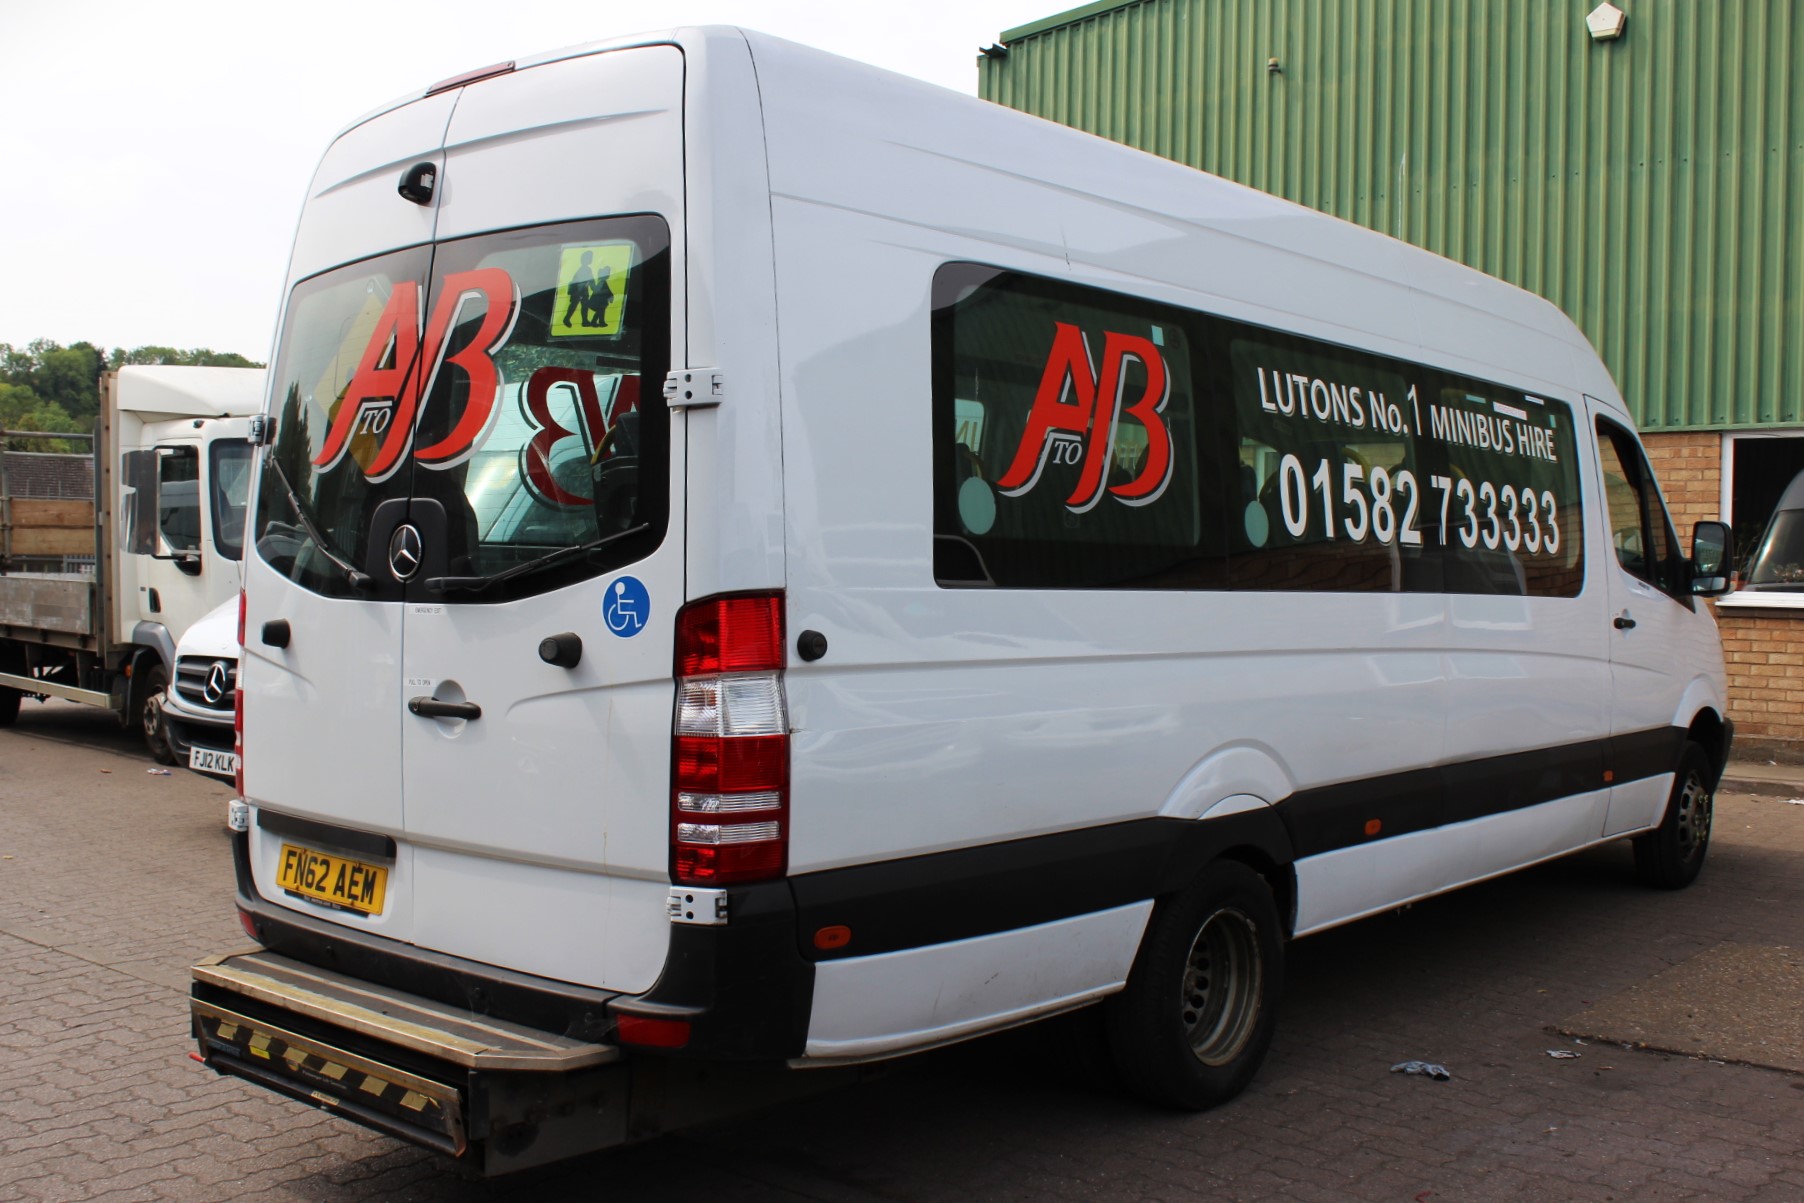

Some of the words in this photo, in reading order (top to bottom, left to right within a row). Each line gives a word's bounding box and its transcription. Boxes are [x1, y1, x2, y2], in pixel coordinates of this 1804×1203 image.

[360, 406, 391, 435] TO
[1257, 367, 1365, 429] LUTONS
[1430, 404, 1514, 454] MINIBUS
[1516, 423, 1557, 462] HIRE
[1053, 441, 1082, 465] TO
[1279, 454, 1423, 548] 01582
[1431, 475, 1560, 556] 733333
[194, 750, 213, 768] FJ12
[215, 754, 235, 772] KLK
[283, 849, 331, 893] FN62
[332, 863, 378, 905] AEM
